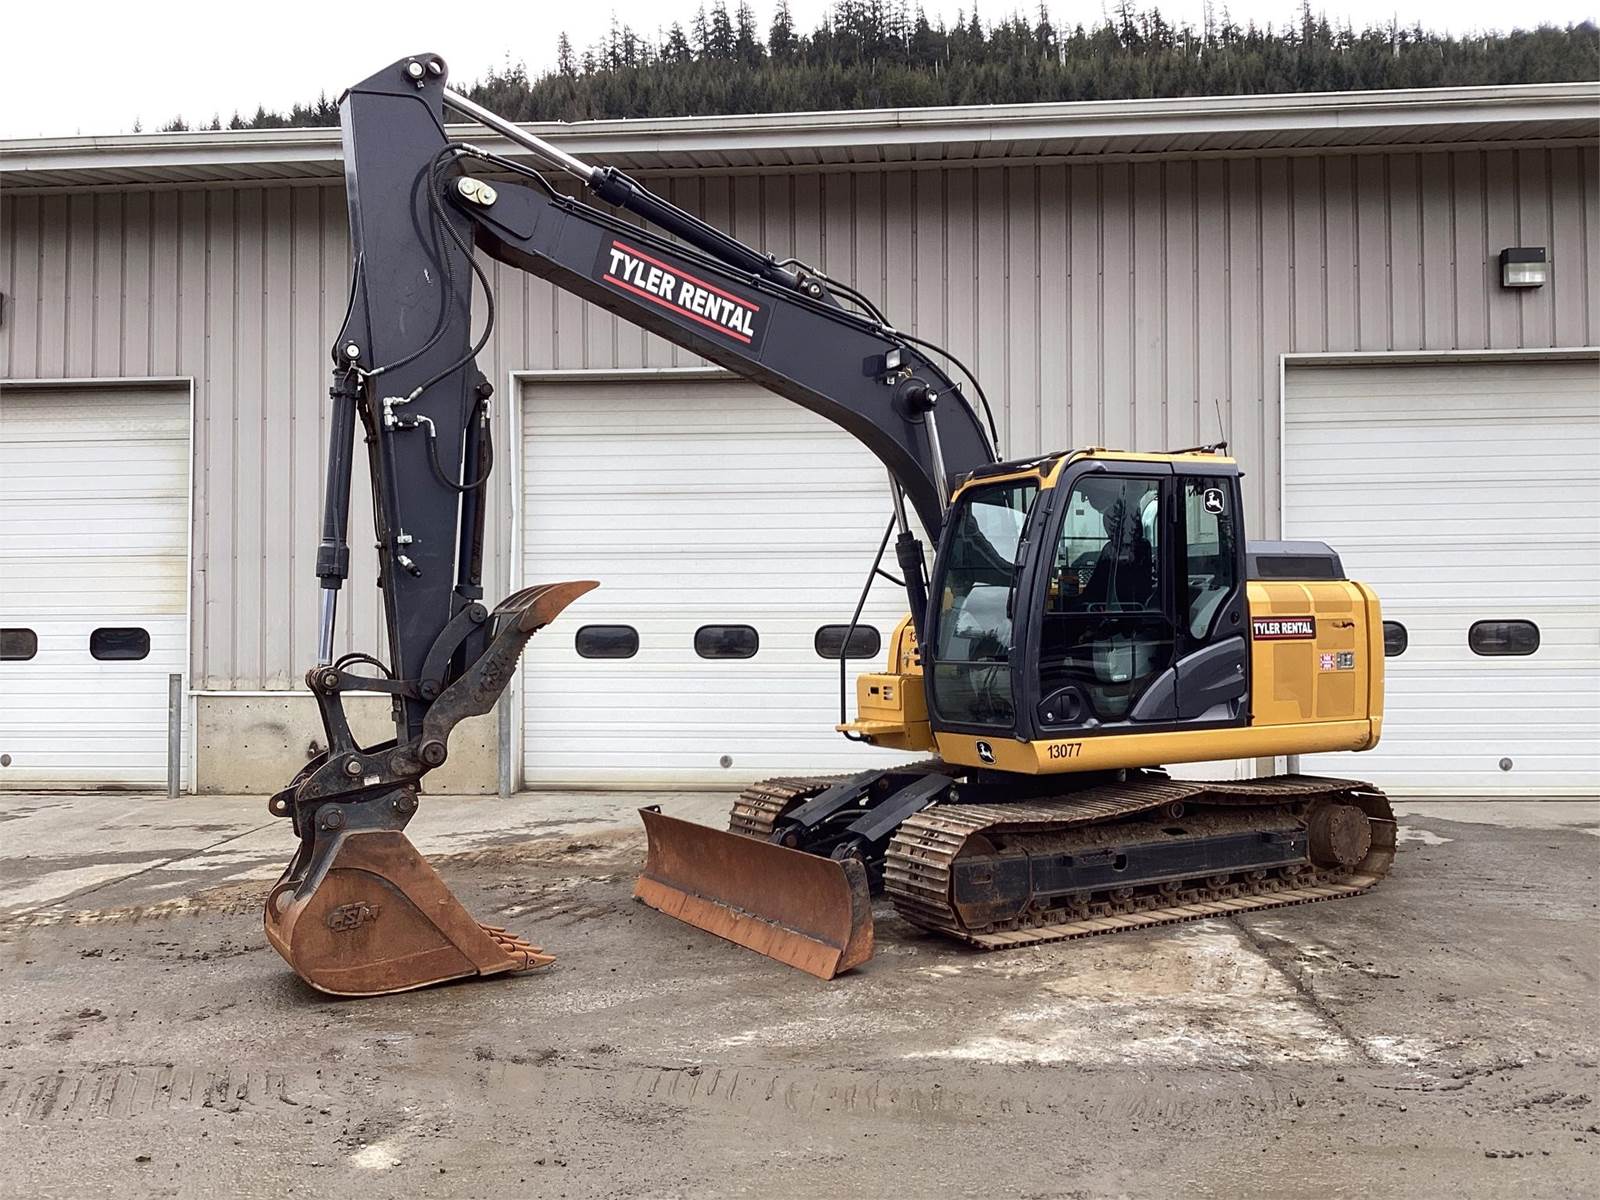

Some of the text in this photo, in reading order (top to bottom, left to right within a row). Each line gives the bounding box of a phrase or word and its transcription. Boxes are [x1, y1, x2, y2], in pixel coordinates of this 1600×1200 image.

[609, 248, 754, 337] TYLER RENTAL
[1254, 621, 1313, 635] TYLER RENTAL
[1047, 743, 1082, 759] 13077
